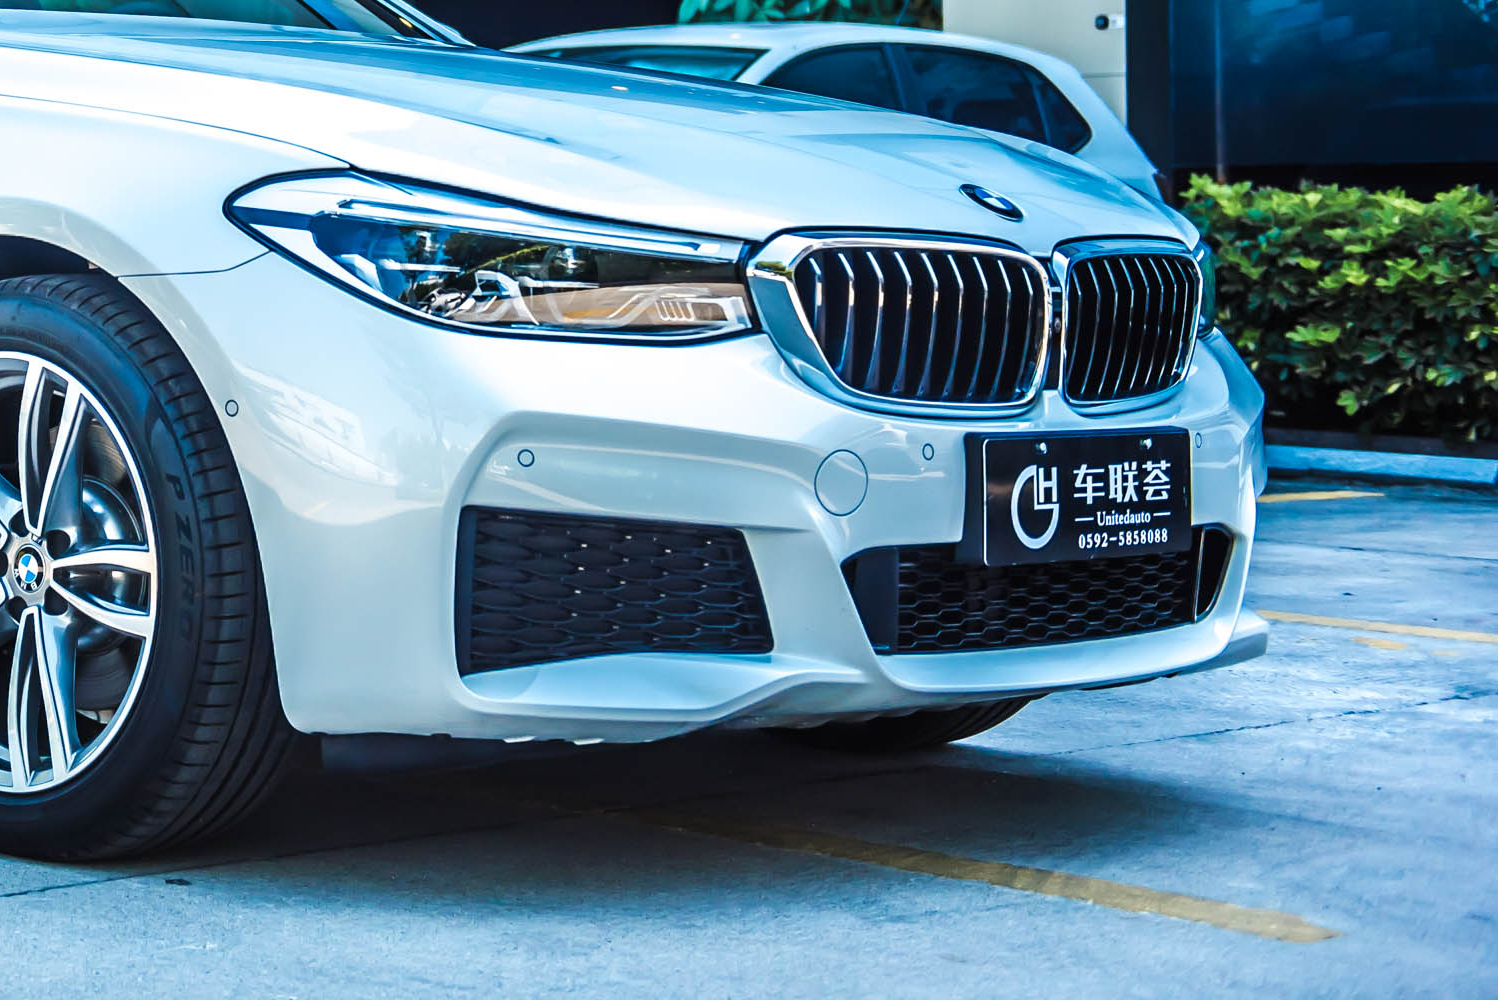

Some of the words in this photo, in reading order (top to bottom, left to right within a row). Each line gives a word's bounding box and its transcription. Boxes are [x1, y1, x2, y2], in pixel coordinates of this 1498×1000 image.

[1072, 460, 1171, 505] 车联荟
[1096, 509, 1151, 528] Unitedauto
[1077, 528, 1169, 550] 0592-5858088
